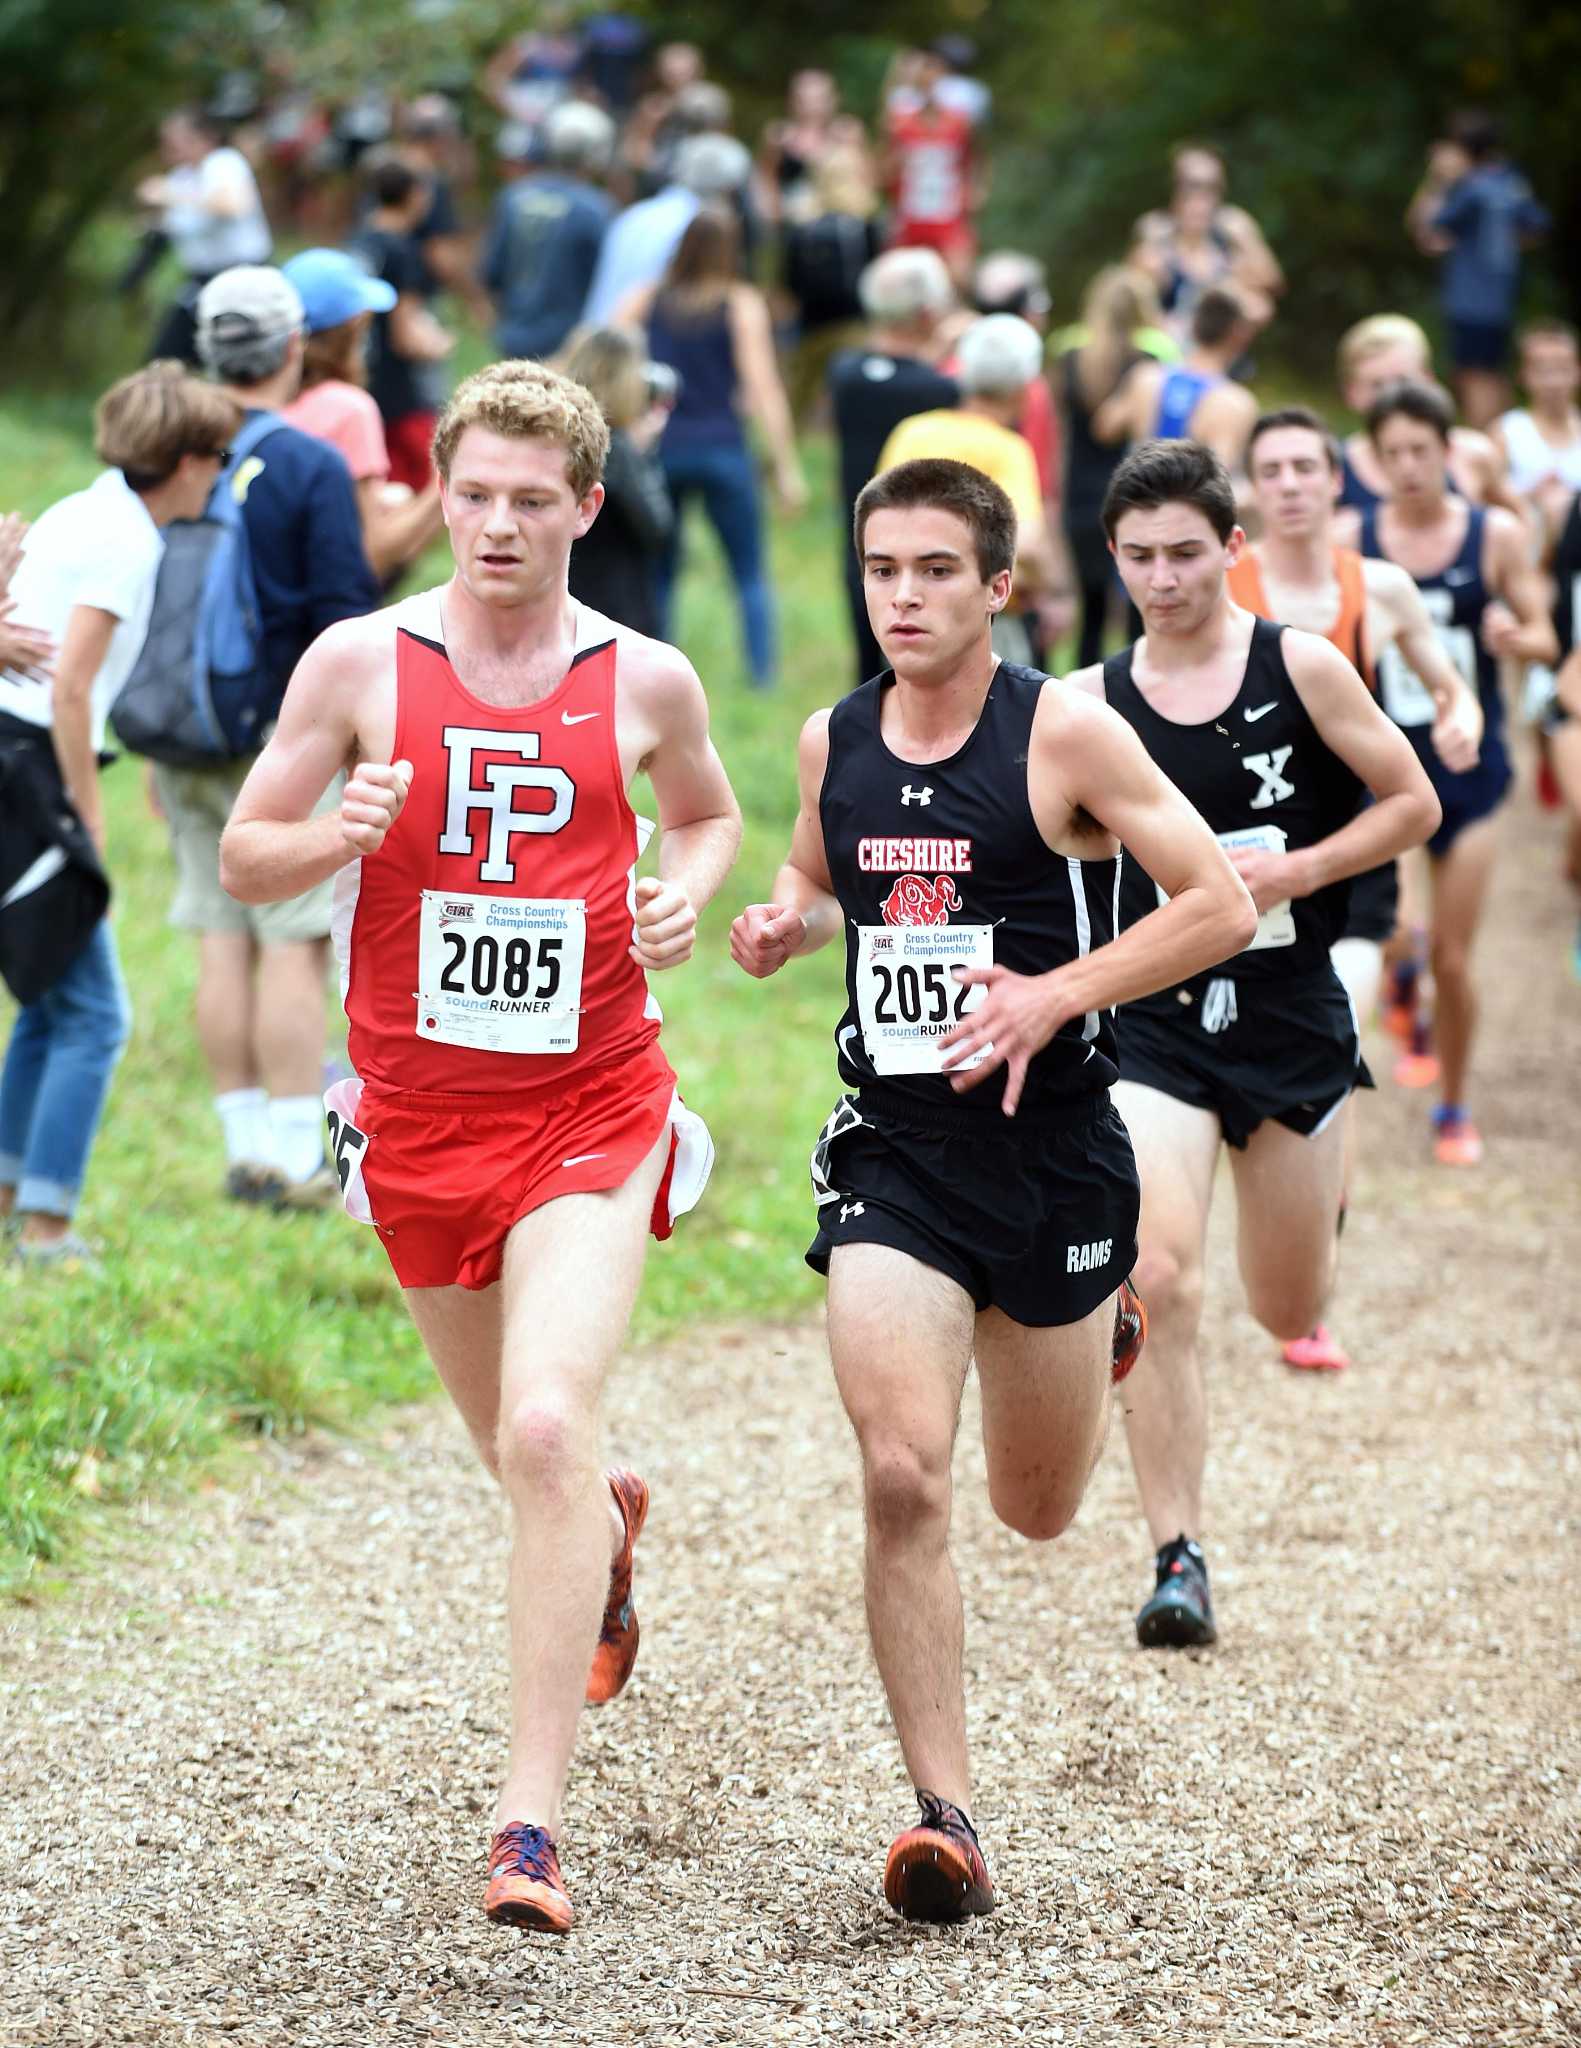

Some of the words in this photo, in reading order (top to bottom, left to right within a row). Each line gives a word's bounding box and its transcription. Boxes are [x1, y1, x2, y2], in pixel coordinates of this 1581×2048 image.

[1242, 744, 1296, 810] X
[438, 725, 577, 884] FP
[857, 837, 973, 873] CHESHIRE
[446, 904, 475, 917] CIAC
[486, 915, 568, 931] Championships
[490, 903, 521, 916] Cross
[524, 906, 566, 919] Country
[903, 944, 977, 956] Championships
[905, 933, 930, 944] Cross
[933, 933, 974, 944] Country
[440, 932, 563, 999] 2085
[1066, 1238, 1113, 1273] RAMS
